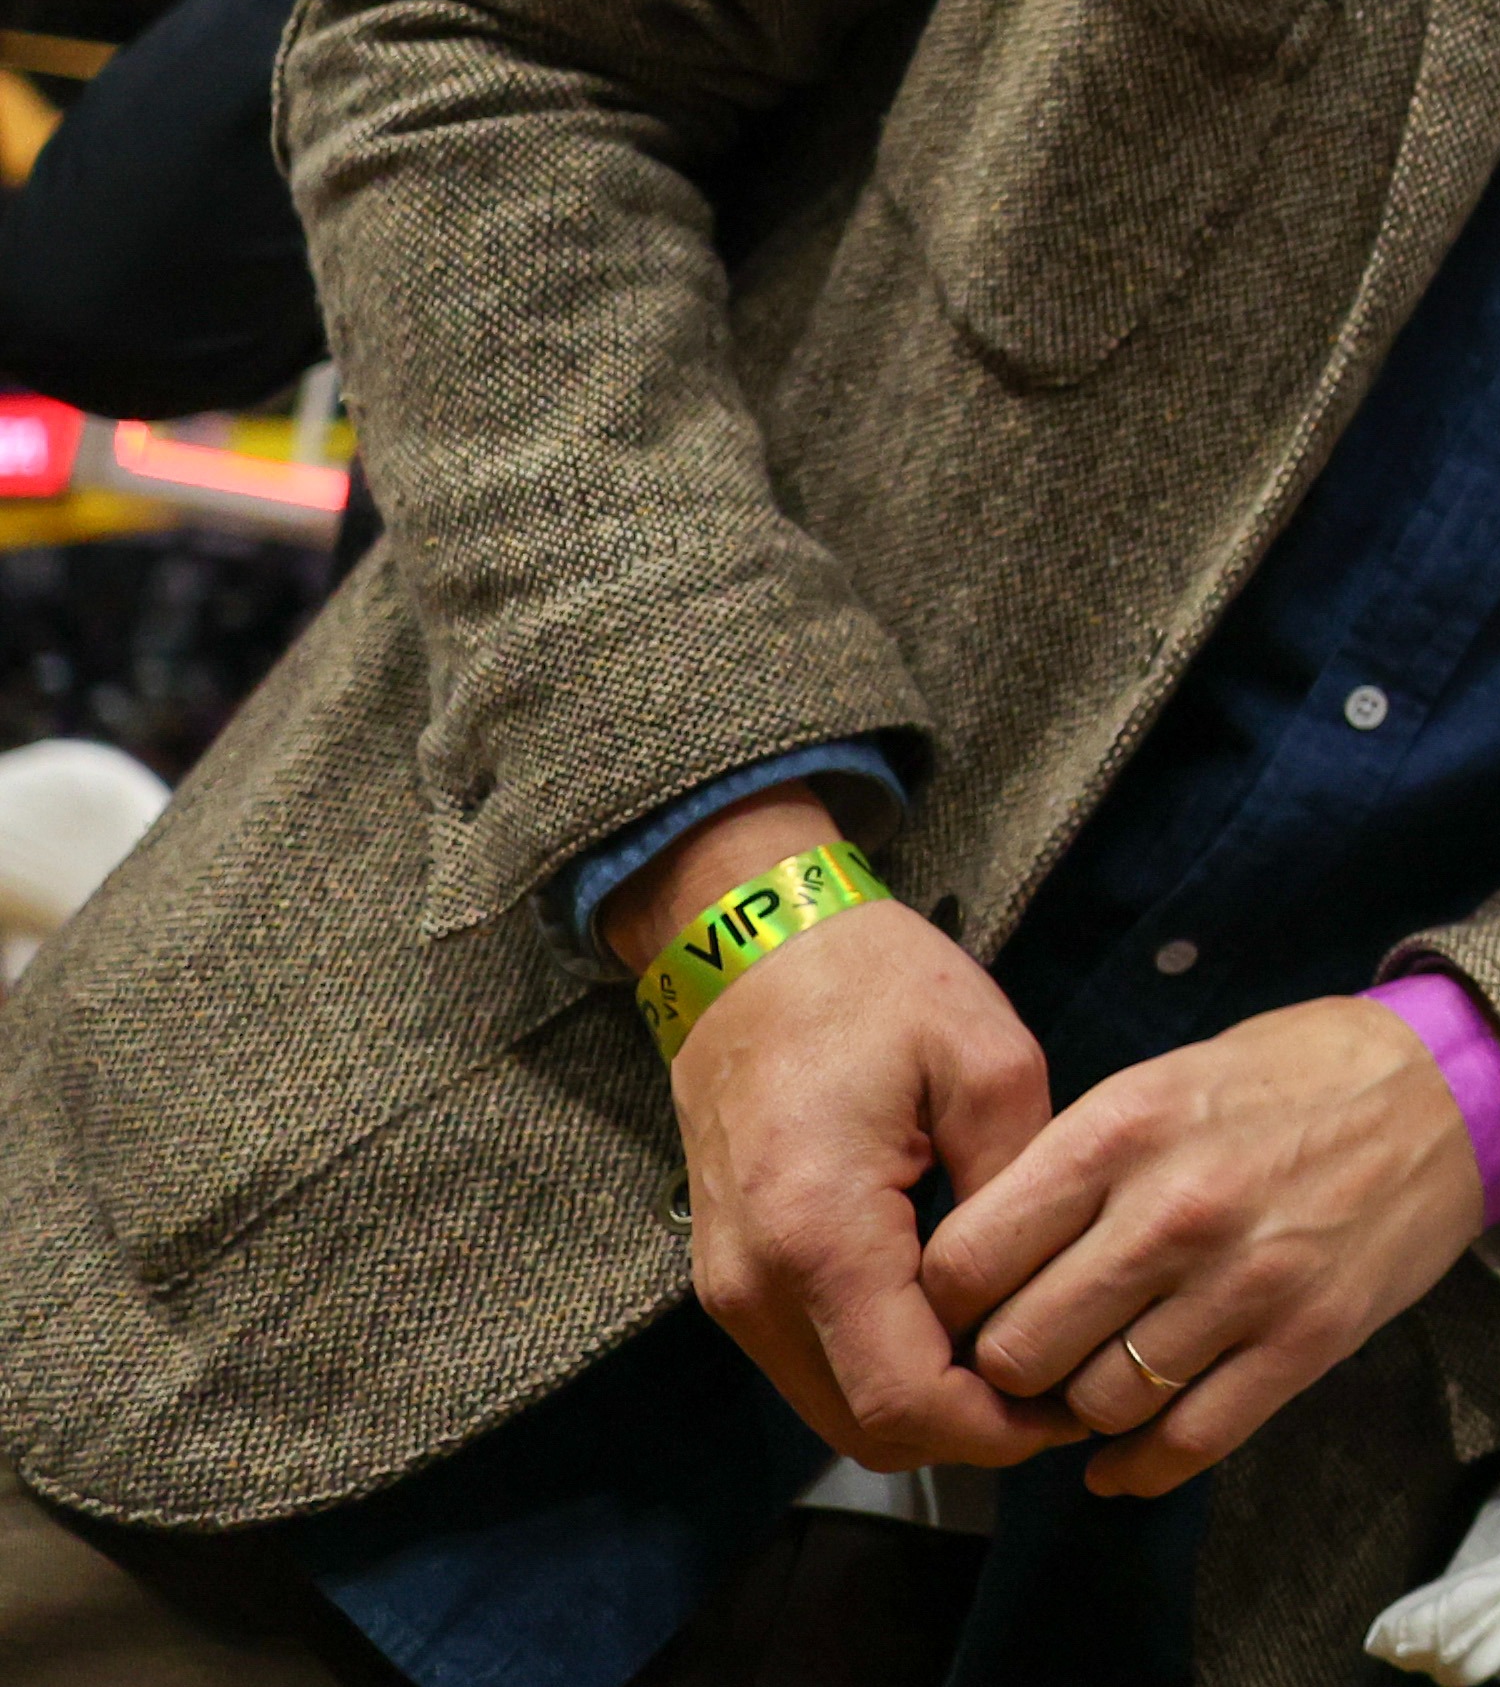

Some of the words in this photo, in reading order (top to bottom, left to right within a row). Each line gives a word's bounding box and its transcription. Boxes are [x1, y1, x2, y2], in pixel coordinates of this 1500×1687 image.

[793, 864, 825, 910] VIP
[684, 888, 781, 972] VIP
[660, 973, 680, 1022] VIP
